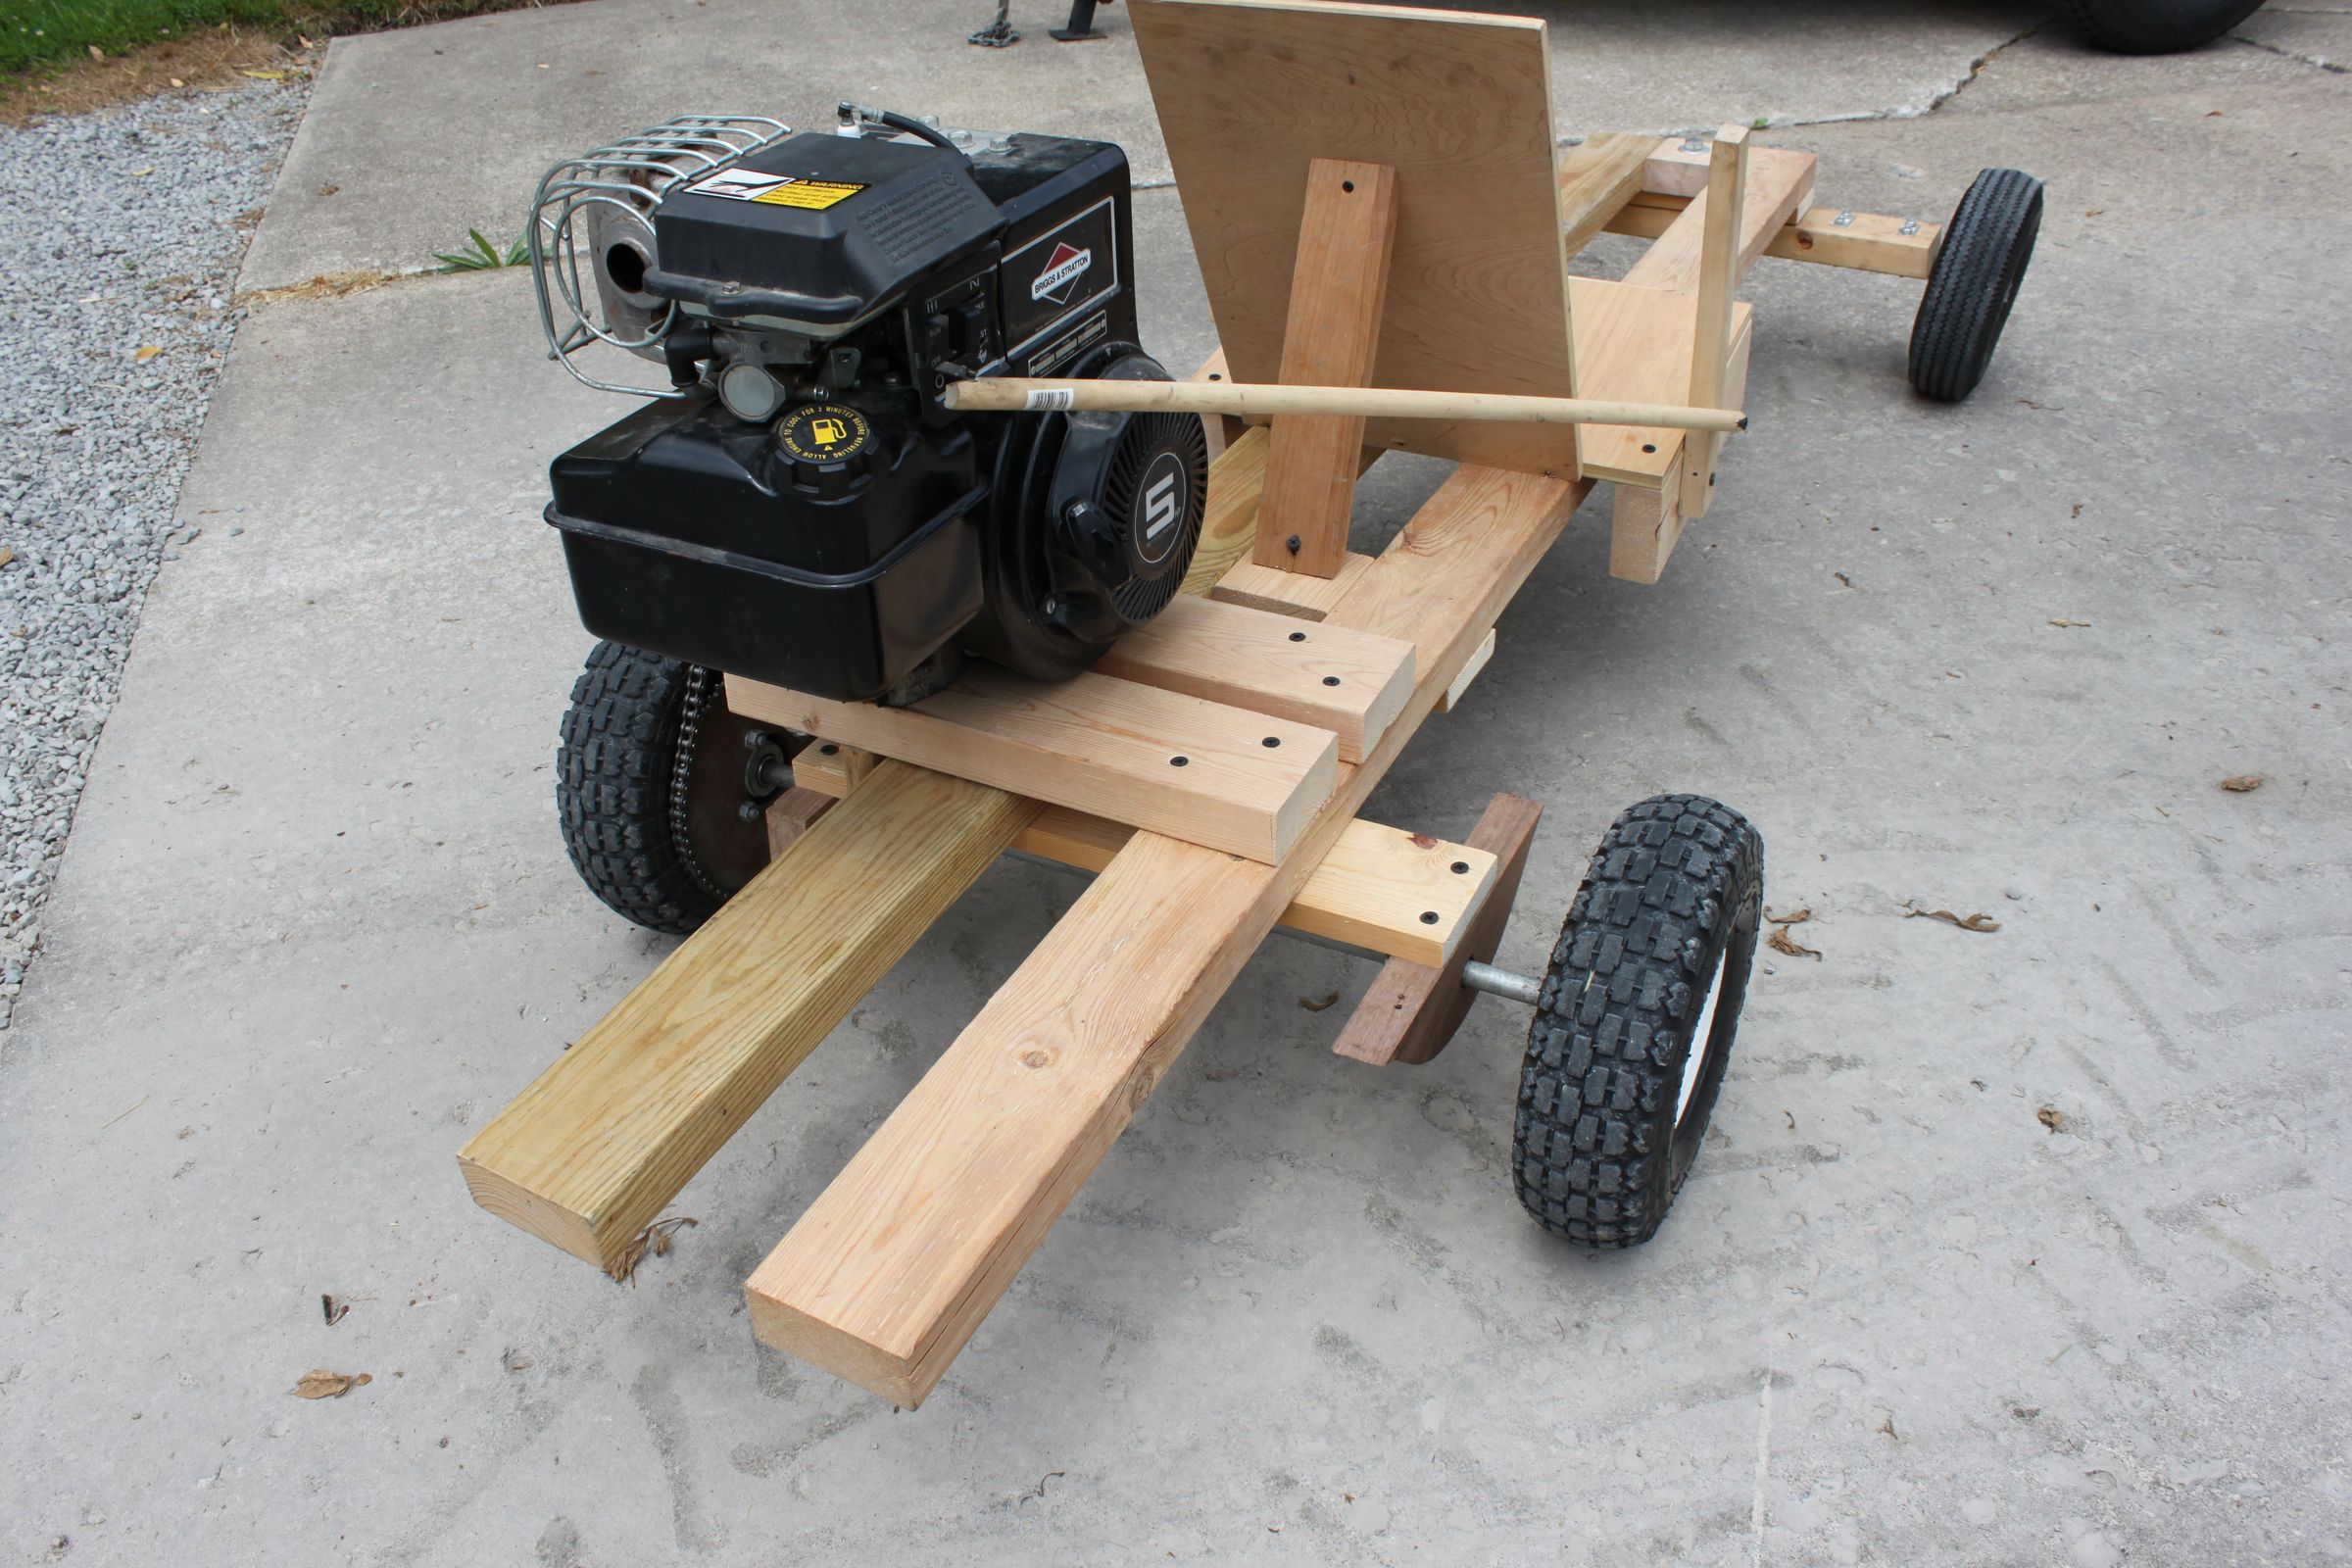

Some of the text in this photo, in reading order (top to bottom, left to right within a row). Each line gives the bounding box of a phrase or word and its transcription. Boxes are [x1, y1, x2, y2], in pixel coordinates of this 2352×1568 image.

[810, 181, 864, 190] WARNING
[1035, 274, 1056, 294] BRIGGS
[1061, 254, 1089, 278] STRATTON
[802, 407, 815, 416] FOR
[826, 406, 855, 418] MINUTES
[787, 416, 801, 427] COOL
[853, 416, 865, 435] BEFORE
[785, 437, 802, 454] ENGINE
[832, 437, 863, 459] REFUELING
[802, 451, 827, 460] ALLOW
[1146, 471, 1175, 540] 5
